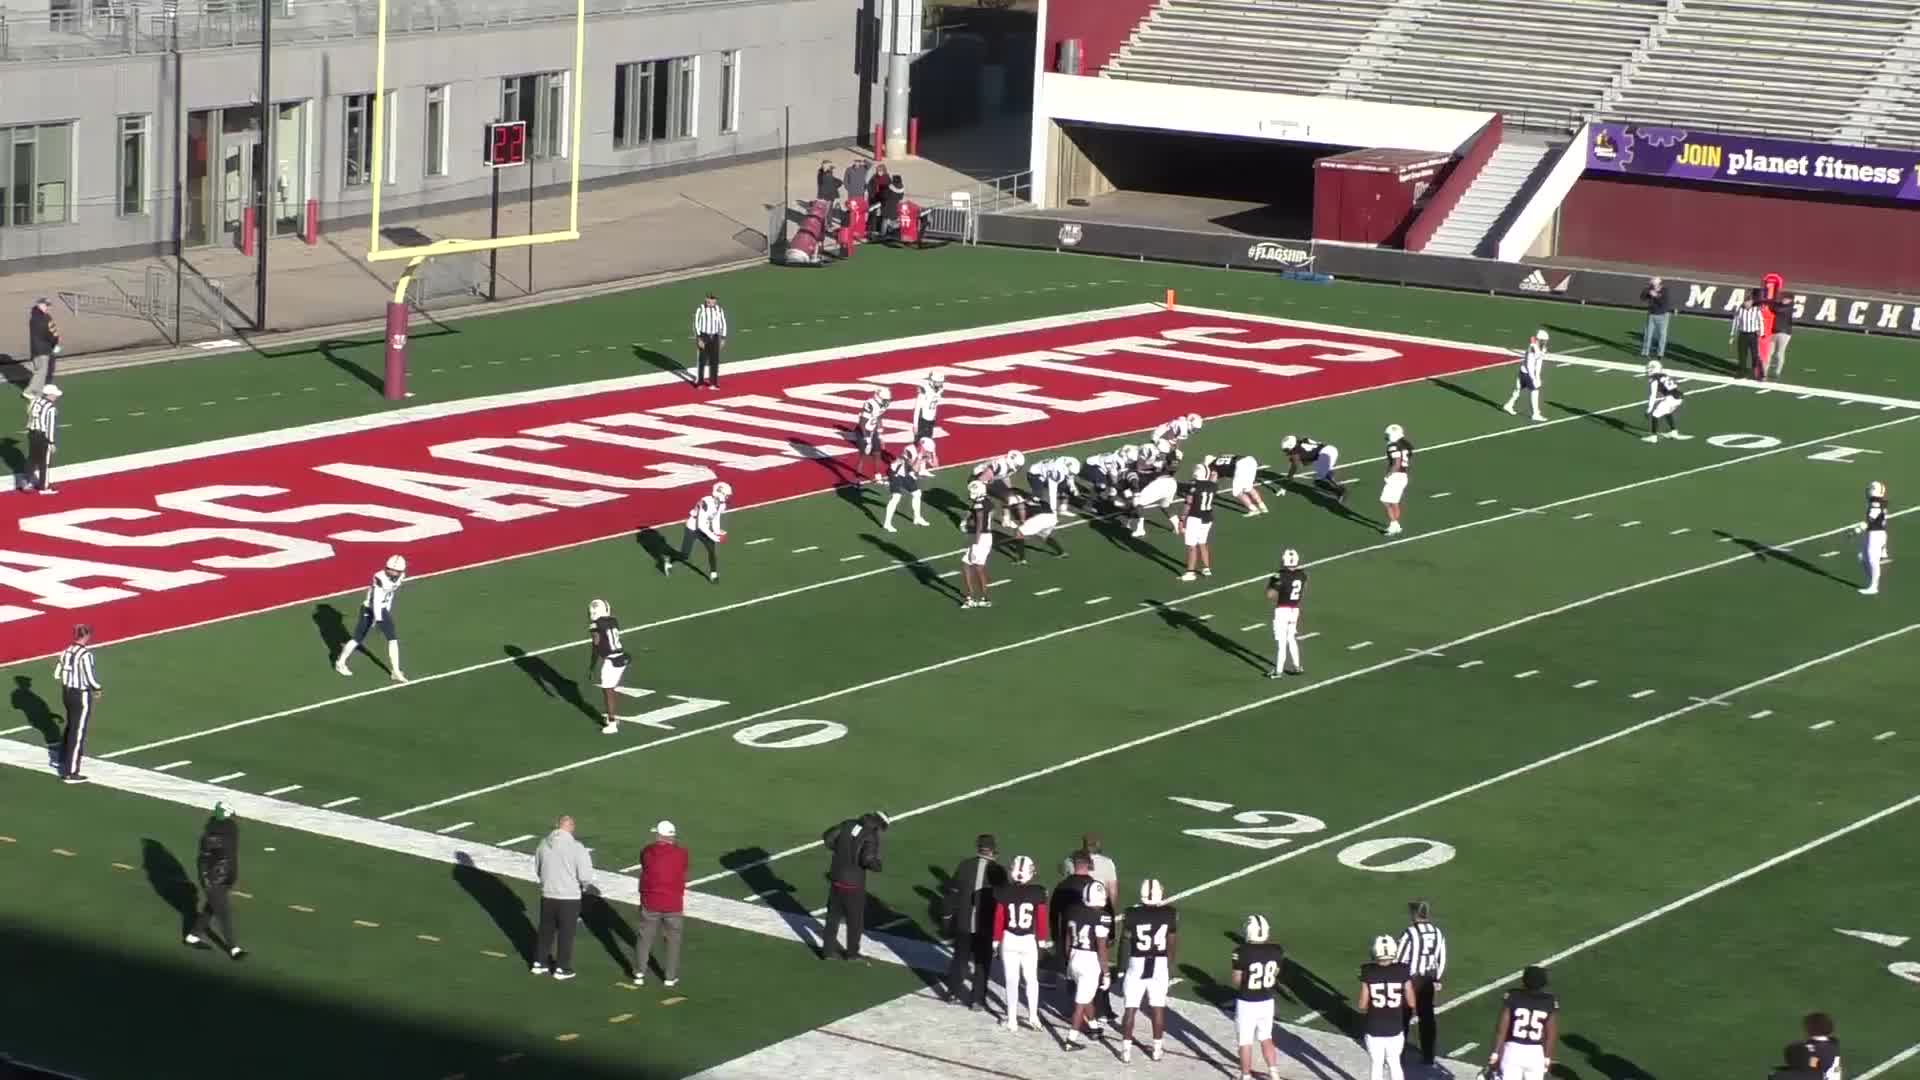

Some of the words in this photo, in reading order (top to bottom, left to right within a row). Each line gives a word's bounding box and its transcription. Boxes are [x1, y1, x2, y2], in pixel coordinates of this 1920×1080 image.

[495, 126, 523, 162] 22
[1676, 143, 1721, 167] JOIN
[1727, 149, 1808, 176] planet
[1814, 155, 1901, 185] fitness
[1247, 245, 1307, 263] #FLAGSHIP
[1685, 284, 1920, 331] MASACH
[0, 326, 1403, 623] ASSACHUSETTS
[1200, 491, 1214, 511] 11
[1290, 579, 1302, 601] 2
[1182, 811, 1456, 872] 20
[1008, 903, 1034, 928] 16
[1068, 920, 1091, 949] 14
[1136, 924, 1168, 951] 54
[1248, 961, 1278, 989] 28
[1370, 982, 1402, 1008] 55
[1512, 1008, 1548, 1040] 25
